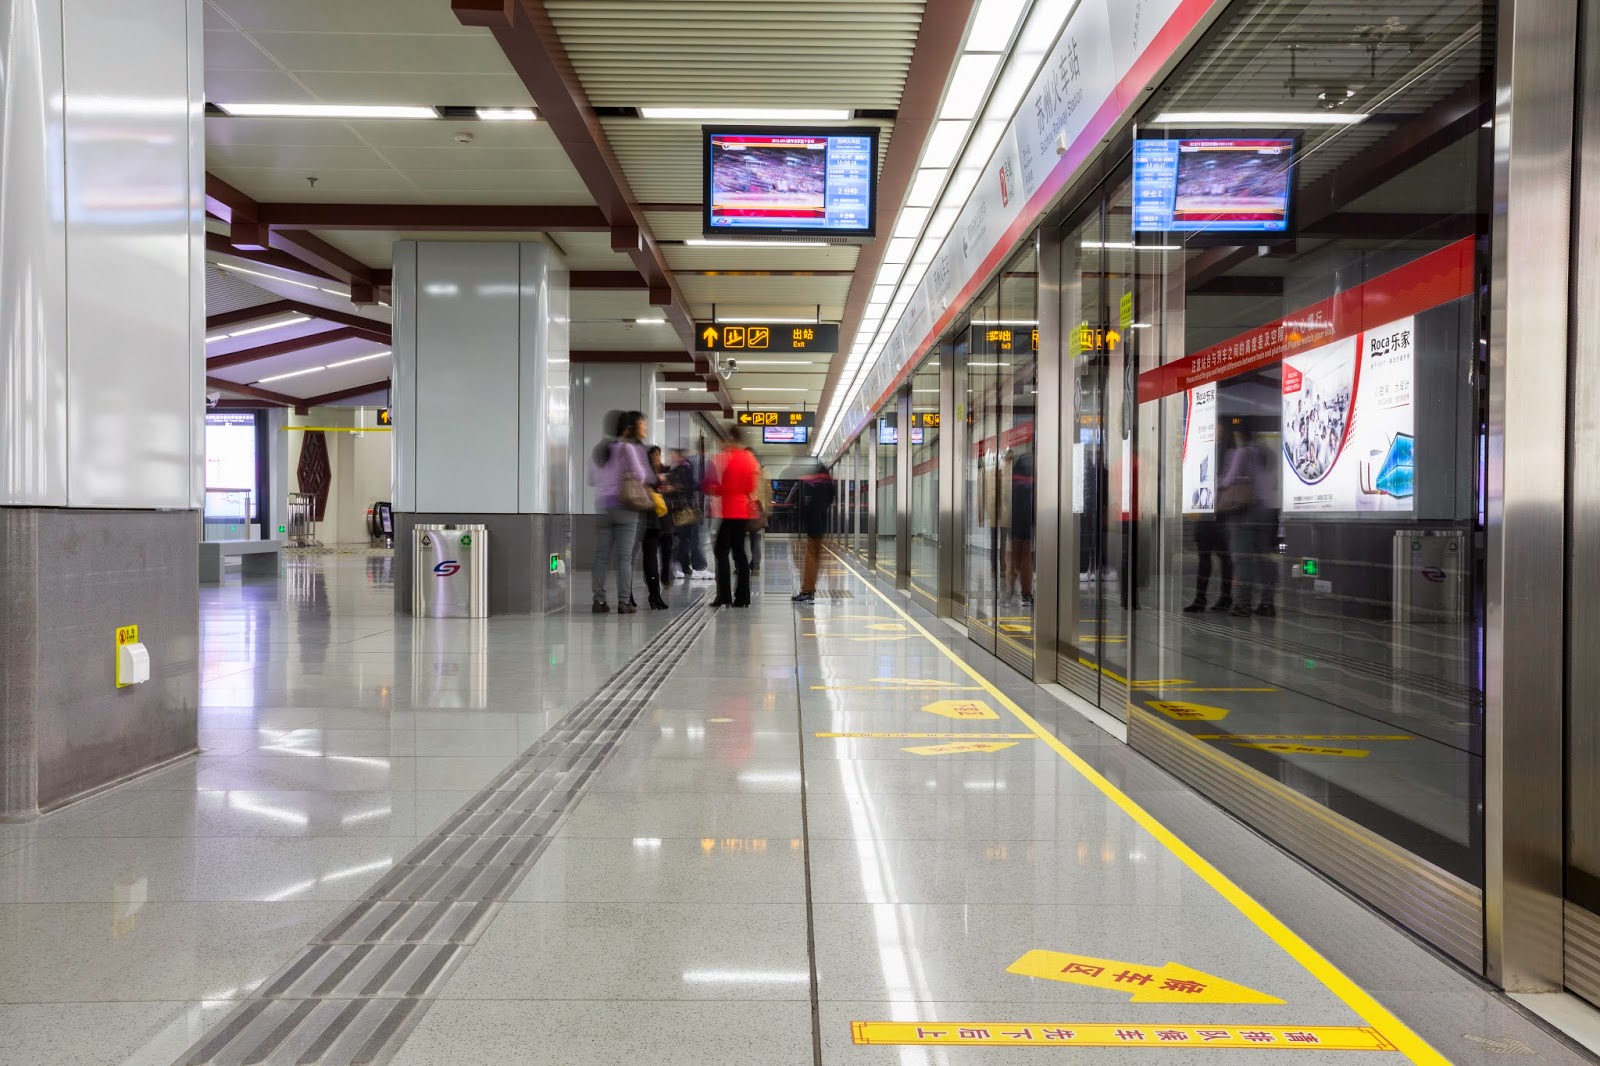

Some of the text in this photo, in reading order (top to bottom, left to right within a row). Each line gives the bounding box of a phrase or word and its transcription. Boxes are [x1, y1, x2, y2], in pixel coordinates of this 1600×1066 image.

[1035, 36, 1081, 135] 苏州火车站
[792, 328, 814, 340] 出站
[1391, 330, 1410, 352] 乐家
[792, 340, 805, 348] Exit
[1060, 962, 1208, 994] 候车区
[916, 1027, 1320, 1044] 请排队候车 先下后上
